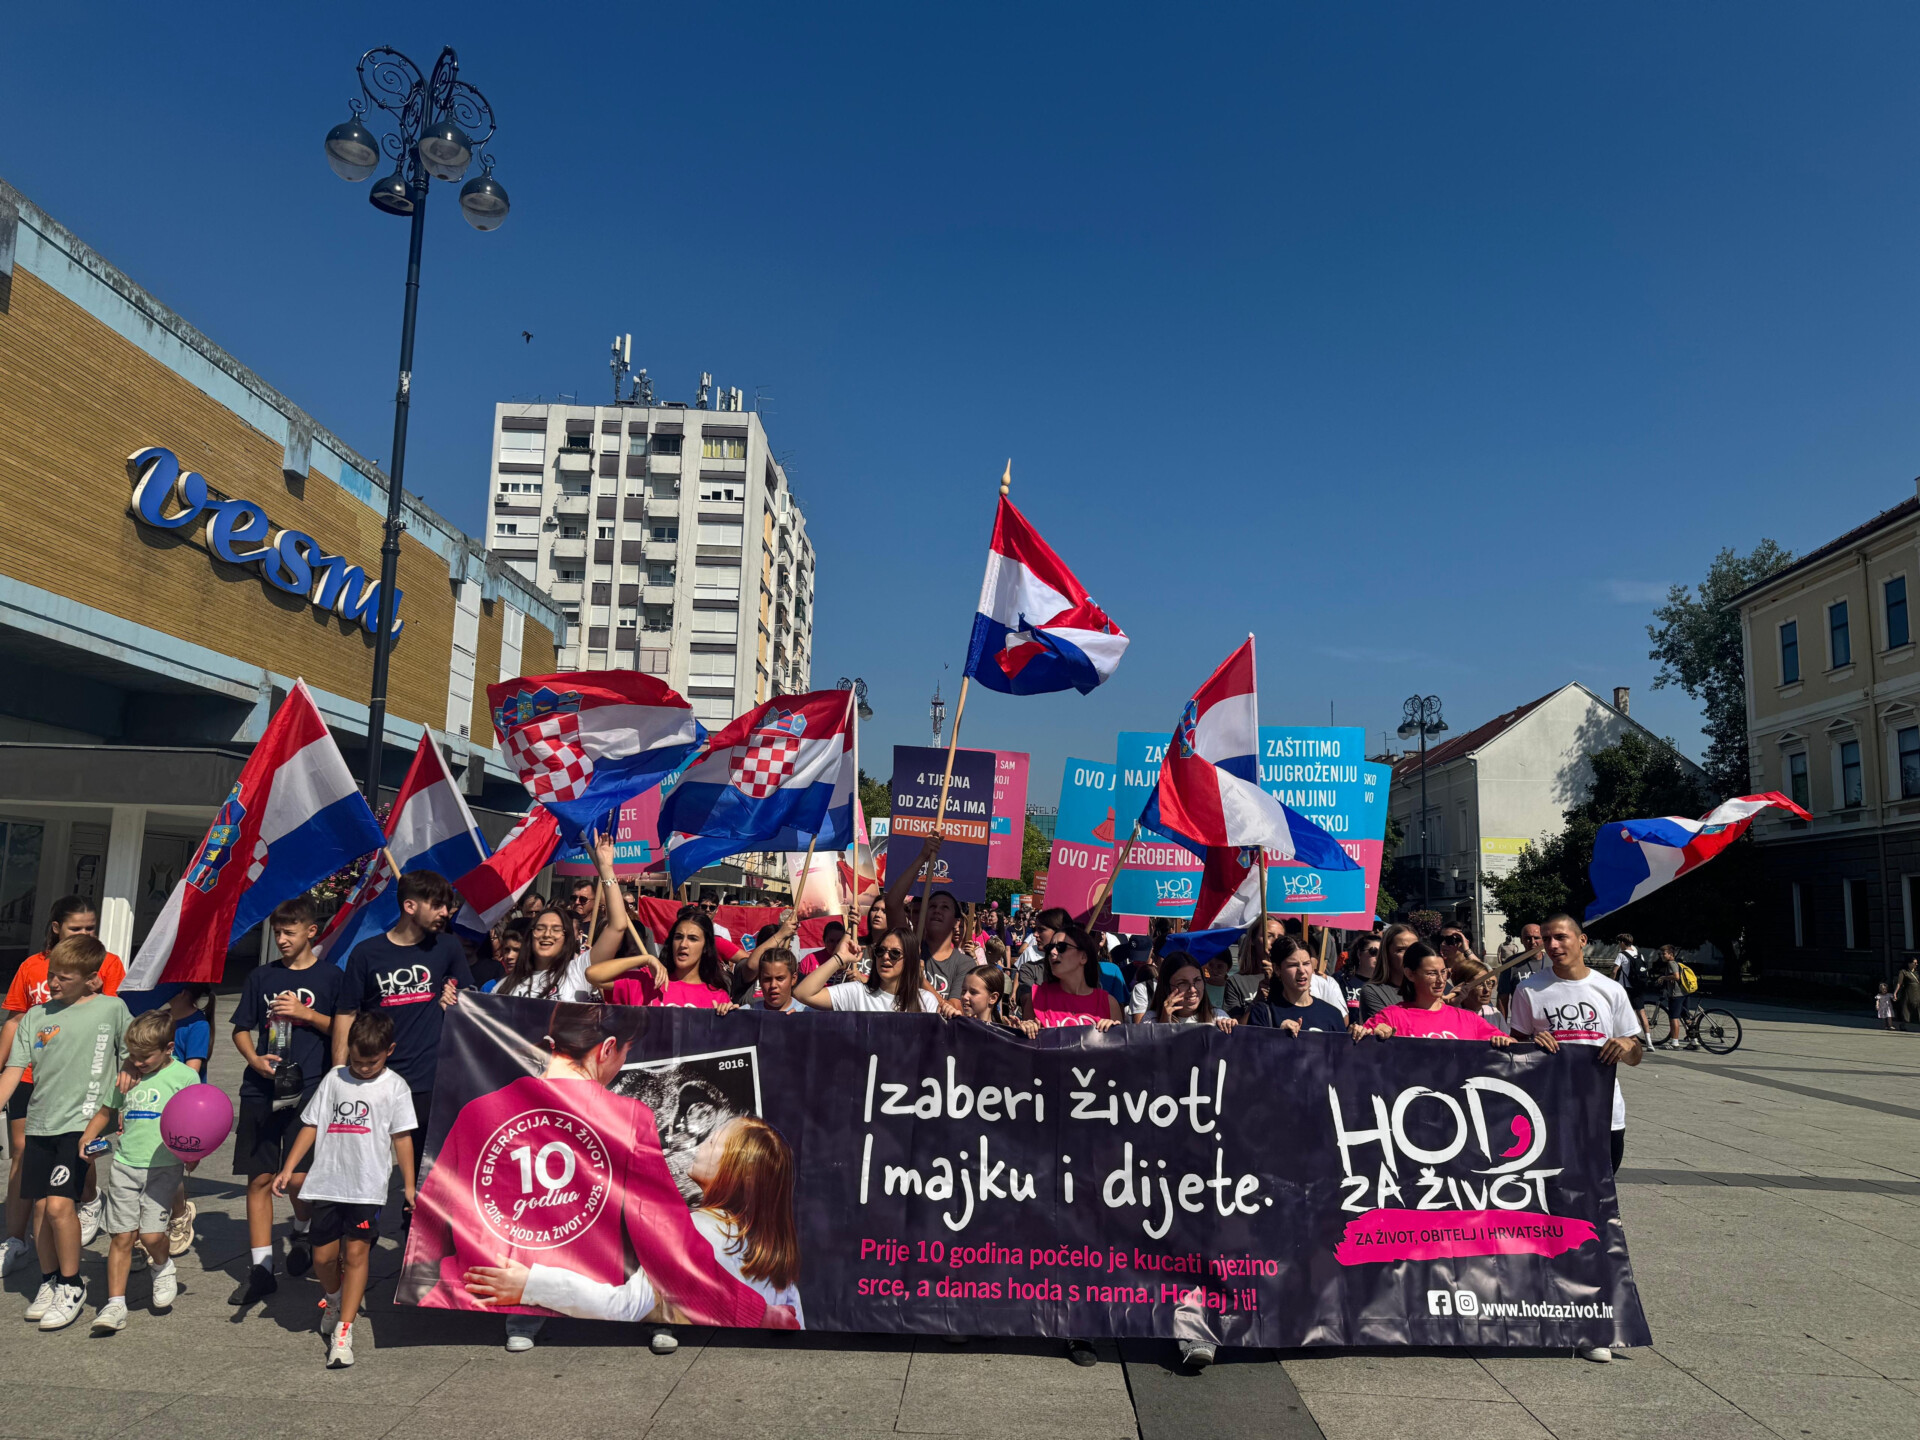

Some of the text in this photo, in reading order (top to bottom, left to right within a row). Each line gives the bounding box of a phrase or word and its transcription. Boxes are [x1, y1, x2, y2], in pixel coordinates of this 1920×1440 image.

[1267, 737, 1341, 758] ZAŠTITIMO
[917, 773, 925, 785] 4
[1074, 768, 1105, 790] OVO
[1259, 762, 1358, 783] AJUGROŽENIJU
[898, 794, 914, 807] OD
[916, 794, 961, 813] ZAČĆA
[963, 801, 986, 815] IMA
[1272, 789, 1336, 807] MANJINU
[875, 823, 887, 835] ZA
[940, 822, 986, 839] PRSTIJU
[1058, 847, 1110, 872] OVO JE
[1155, 878, 1193, 893] HOD
[1283, 873, 1322, 890] HOD
[376, 964, 431, 990] HOD
[400, 982, 433, 995] ŽIVOT
[1543, 1001, 1597, 1024] HOD
[719, 1058, 749, 1071] 2016.
[82, 1034, 109, 1118] BRAWL STARS
[864, 1054, 1227, 1141] Izaberi život!
[333, 1100, 369, 1119] HOD
[1328, 1076, 1547, 1178] HOD
[169, 1131, 201, 1146] HOD
[481, 1115, 604, 1187] GENERACIJA ZA ŽIVOT
[510, 1141, 576, 1194] 10
[859, 1133, 1273, 1239] I majku i dijete.
[1340, 1161, 1564, 1216] ZA ŽIVOT
[512, 1188, 580, 1221] godina
[585, 1182, 604, 1213] 2025.
[484, 1199, 583, 1242] 2016. HOD ZA ŽIVOT
[1354, 1225, 1564, 1246] ZA ŽIVOT, OBITELJ I HRVATSKU
[860, 1238, 1279, 1281] Prije 10 godina počelo je kucati njezino
[857, 1277, 910, 1301] srce,
[916, 1279, 930, 1297] a
[935, 1275, 1002, 1299] danas
[1008, 1276, 1062, 1301] hoda
[1068, 1284, 1080, 1302] s
[1086, 1284, 1154, 1304] nama.
[1160, 1283, 1227, 1314] Hodaj
[1241, 1287, 1258, 1311] ti!
[1481, 1299, 1614, 1319] www.hodzazivot.hr
